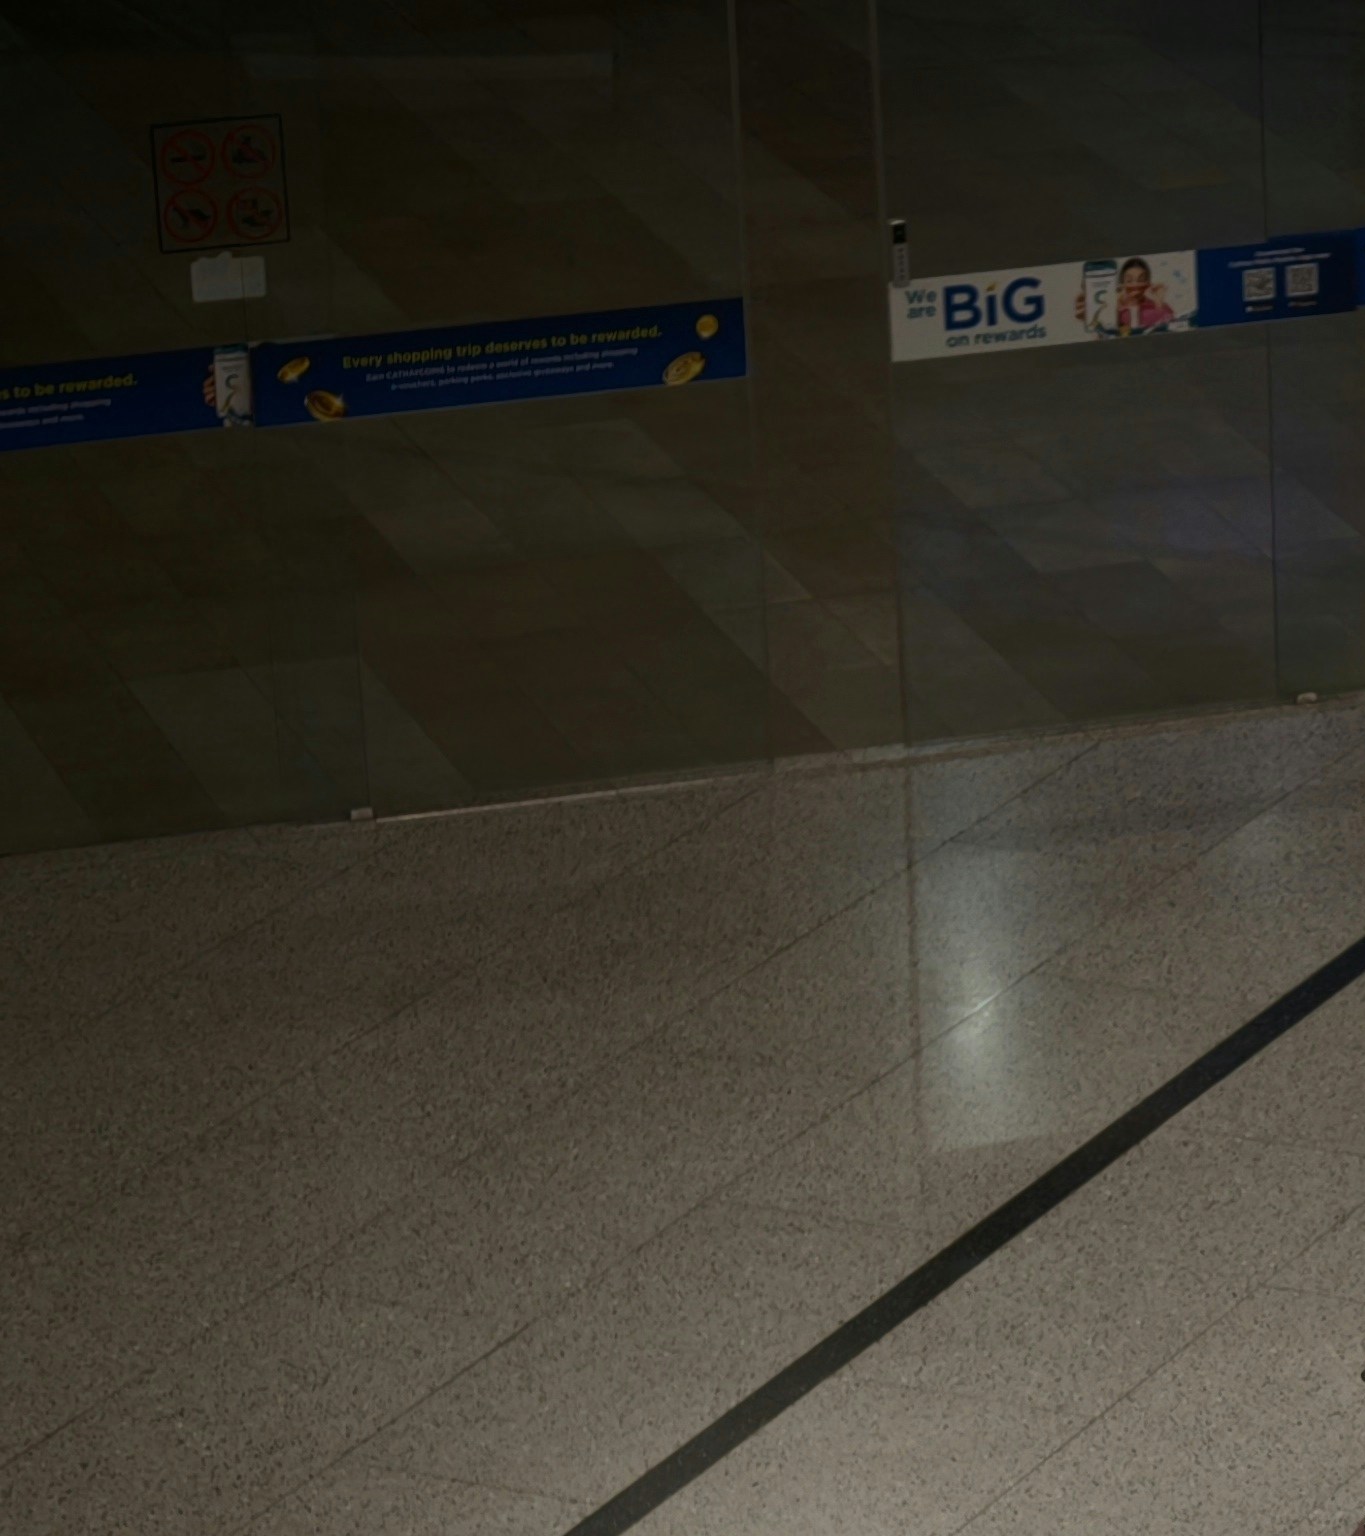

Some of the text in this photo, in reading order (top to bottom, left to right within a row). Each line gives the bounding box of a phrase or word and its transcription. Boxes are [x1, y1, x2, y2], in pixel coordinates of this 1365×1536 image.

[904, 289, 936, 303] We
[907, 305, 936, 318] are
[945, 324, 1046, 347] on rewards
[342, 354, 383, 369] Every
[386, 347, 452, 363] shopping
[456, 343, 482, 358] trip
[485, 337, 547, 354] deserves
[552, 335, 567, 347] to
[570, 333, 588, 345] be
[592, 324, 662, 343] rewarded.
[13, 386, 31, 399] to
[34, 383, 55, 396] be
